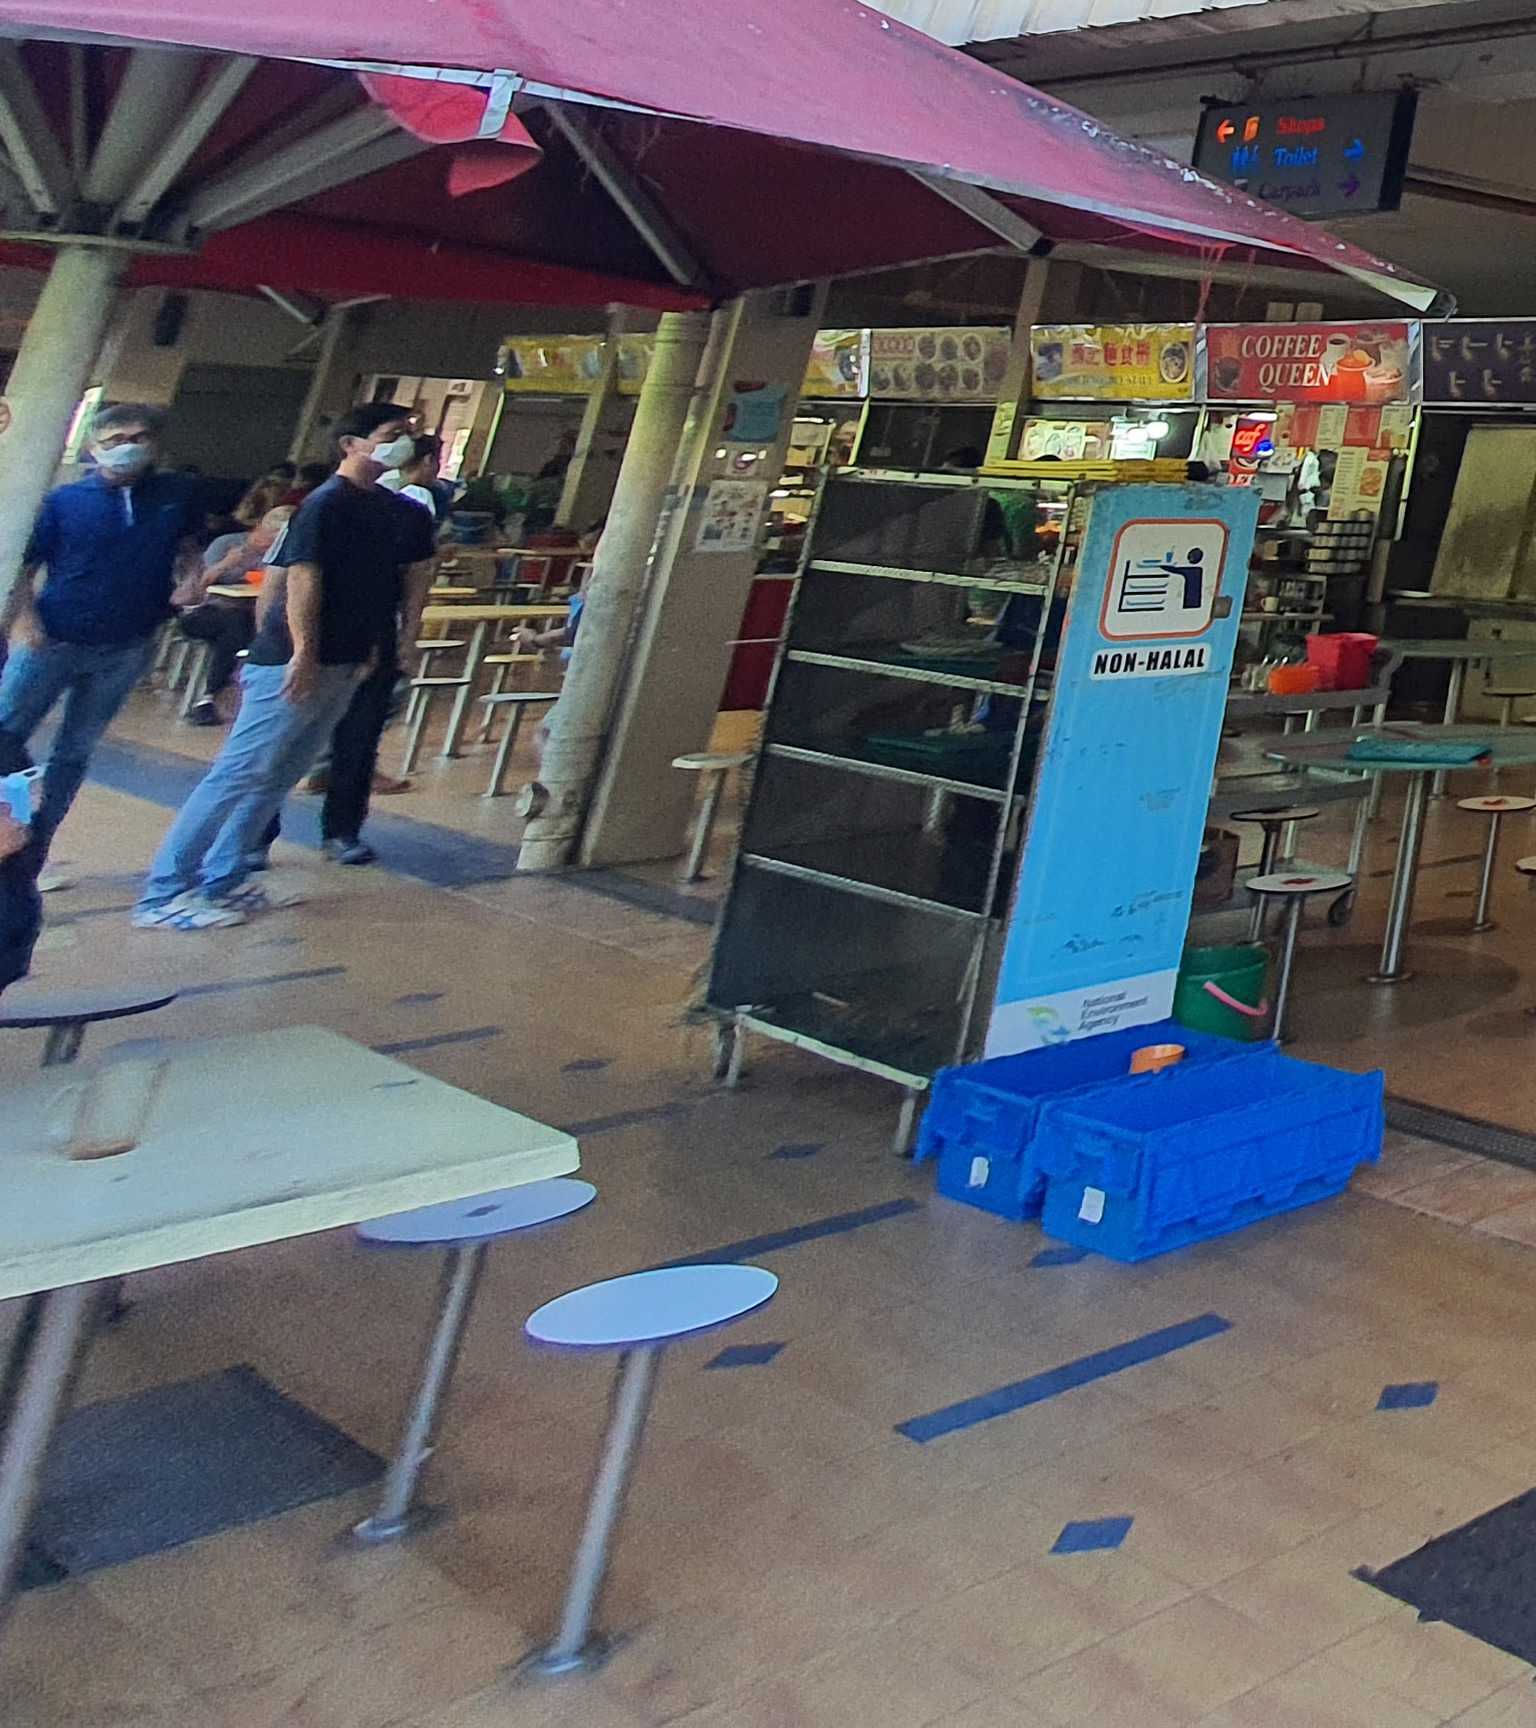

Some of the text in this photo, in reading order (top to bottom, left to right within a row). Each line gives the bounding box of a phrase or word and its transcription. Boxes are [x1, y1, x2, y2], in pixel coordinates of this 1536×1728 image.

[1273, 145, 1320, 167] Toilet
[1240, 334, 1323, 359] COFFEE
[1258, 363, 1336, 392] QUEEN
[1094, 648, 1205, 674] NON-HALAL
[1081, 996, 1149, 1021] Environment
[1082, 991, 1127, 1008] National
[1078, 1015, 1121, 1032] Agency
